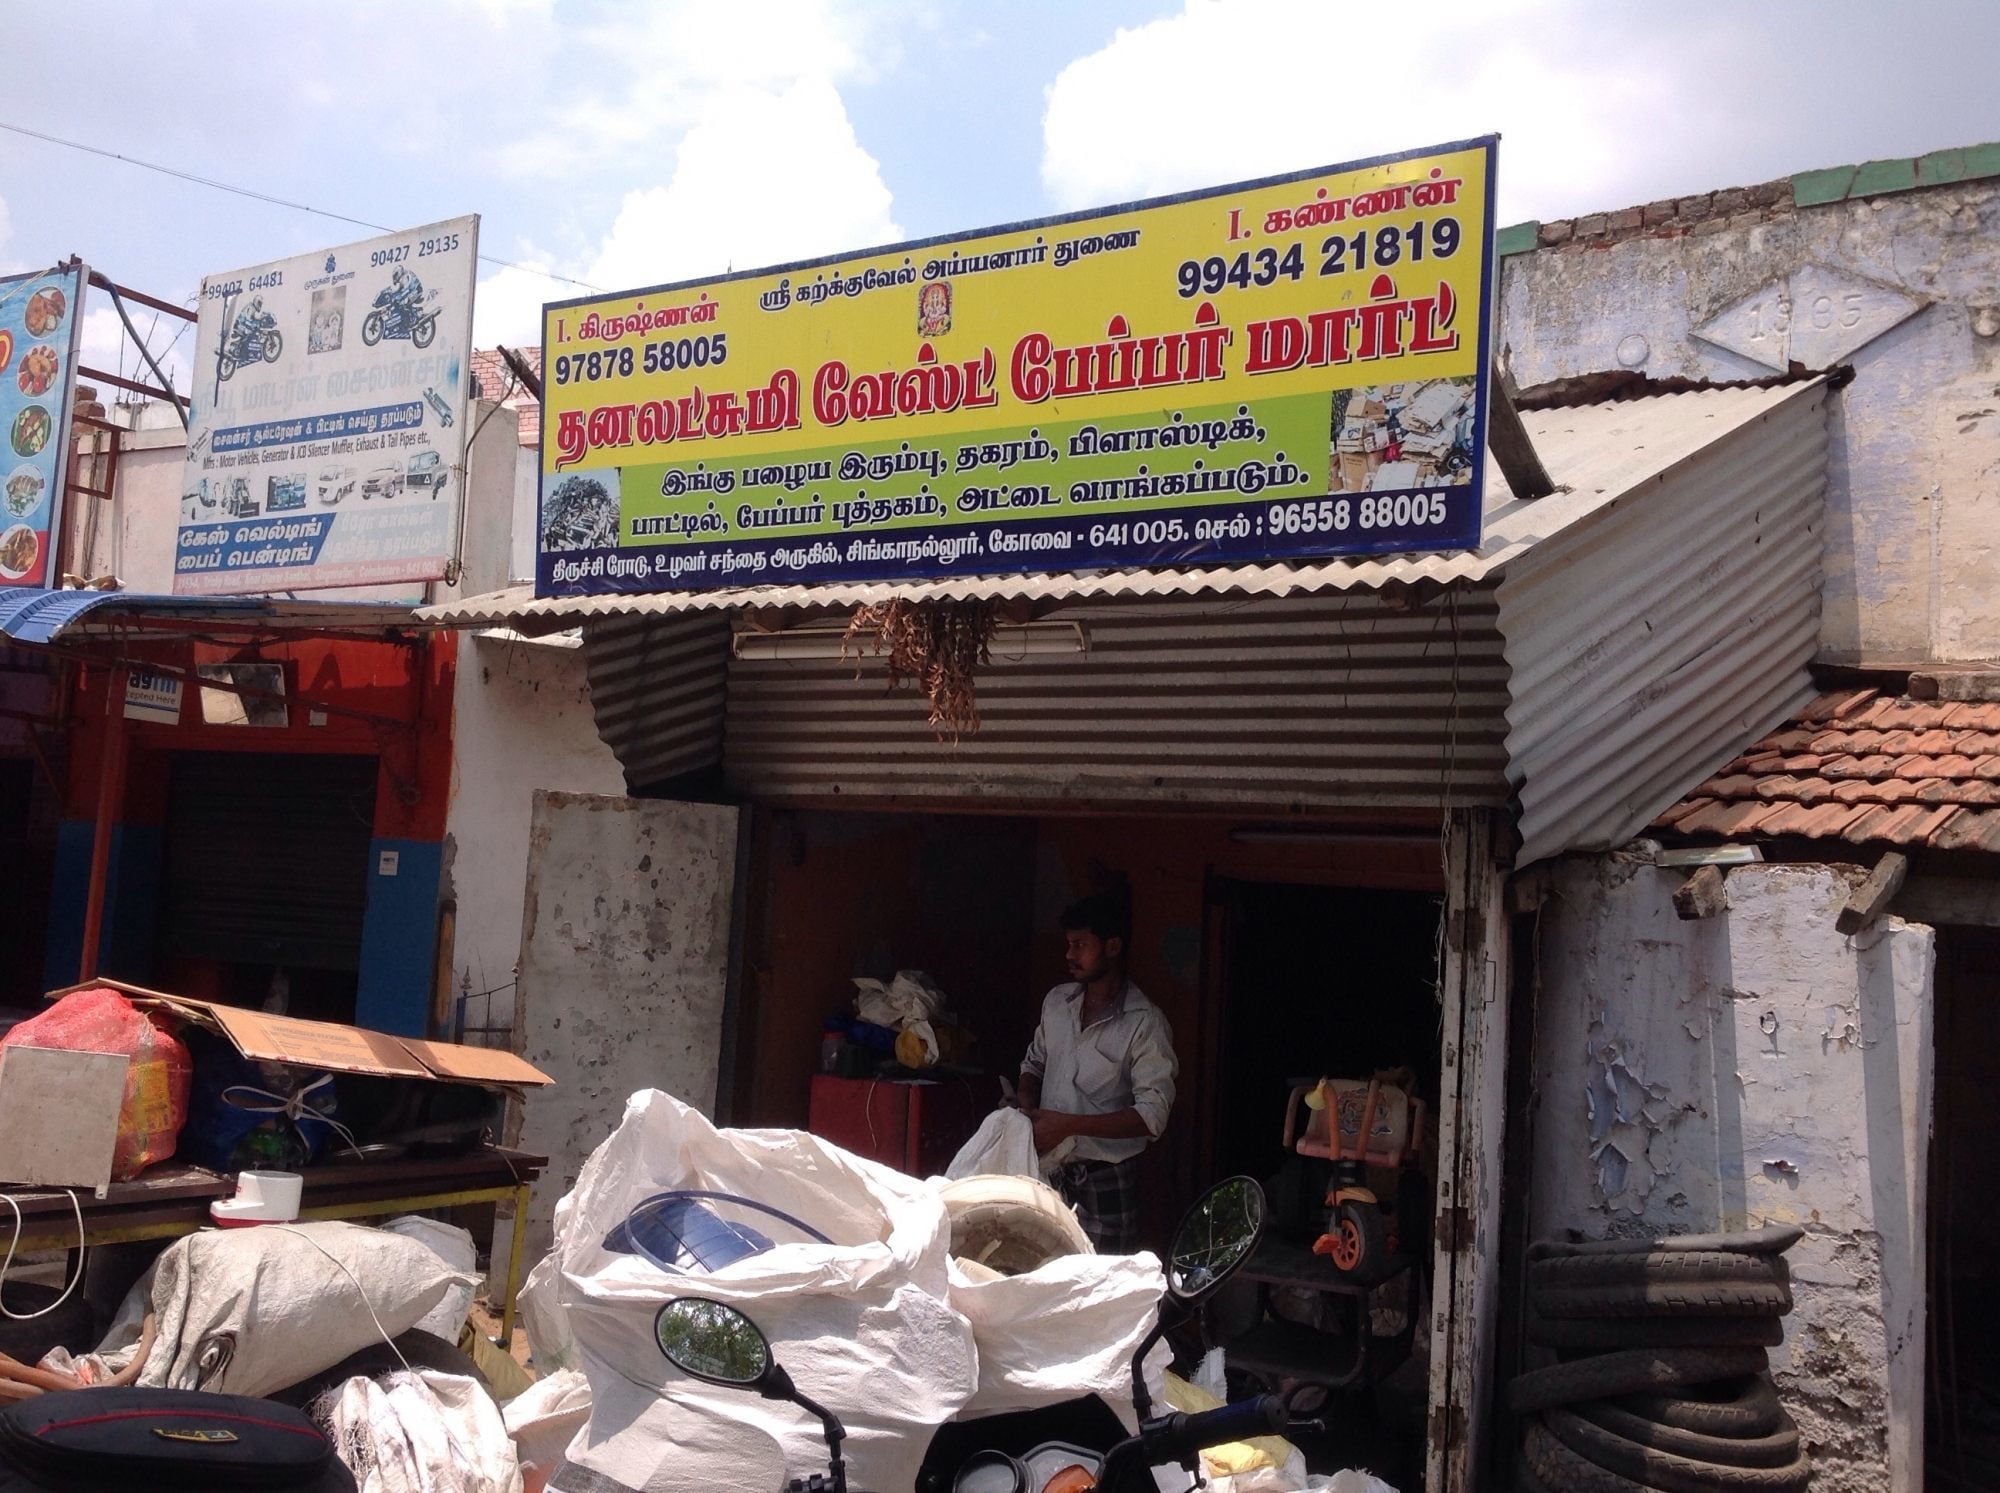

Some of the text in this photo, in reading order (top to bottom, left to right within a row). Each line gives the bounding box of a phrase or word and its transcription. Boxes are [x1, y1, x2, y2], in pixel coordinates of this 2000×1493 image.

[1264, 168, 1462, 234] கண்ணன்
[371, 234, 459, 268] 90427 29135
[922, 237, 1048, 280] அய்யனார்
[1054, 229, 1140, 266] துணை
[1178, 218, 1460, 298] 99434 21819
[249, 271, 284, 291] 64481
[579, 292, 719, 342] கிருஷ்ணன்
[555, 334, 727, 385] 97878 58005
[555, 273, 1459, 472] தனலட்சுமி வேஸ்ட் பேப்பர் மார்ட்
[306, 422, 313, 435] &
[381, 404, 421, 428] தரப்படும்
[220, 454, 237, 469] Motor
[262, 448, 290, 463] Generator
[307, 442, 330, 458] Silencer
[356, 436, 379, 452] Exhaust
[380, 434, 386, 449] &
[388, 432, 398, 448] Tail
[399, 432, 416, 450] Pipes
[662, 405, 1267, 496] இங்கு பழைய இரும்பு, தகரம், பிளாஸ்டிக்,
[631, 453, 1310, 539] பாட்டில், பேப்பர் புத்தகம், அட்டை வாங்கப்படும்.
[179, 517, 322, 548] கேஸ் வெல்டிங்
[552, 556, 604, 583] திருச்சி
[607, 554, 652, 578] ரோடு,
[655, 550, 706, 579] உழவர்
[710, 548, 767, 575] சந்தை
[770, 541, 843, 569] அருகில்,
[989, 528, 1072, 553] கோவை
[1089, 523, 1127, 547] 641
[1269, 499, 1351, 535] 96558
[1360, 492, 1446, 529] 88005
[177, 548, 222, 570] பைப்
[129, 671, 177, 695] aytm
